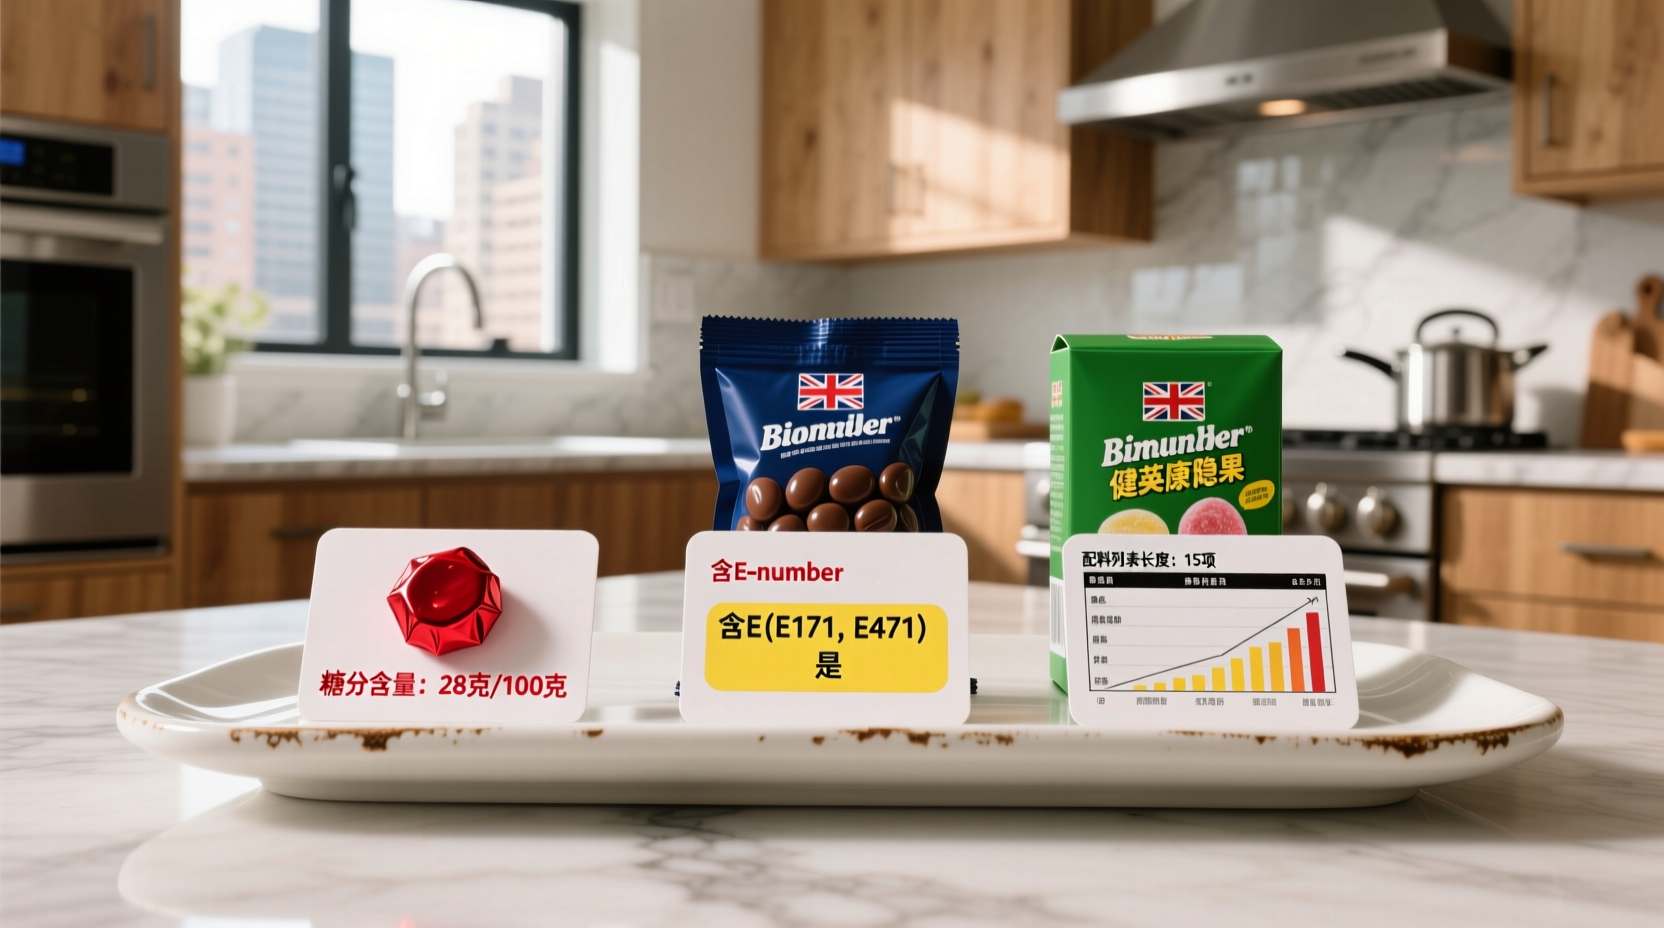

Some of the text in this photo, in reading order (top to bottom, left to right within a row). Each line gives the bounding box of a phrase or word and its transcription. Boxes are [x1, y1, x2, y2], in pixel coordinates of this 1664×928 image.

[711, 558, 844, 582] 含E-number
[718, 612, 926, 643] 含E(E171, E471)
[815, 651, 842, 679] 是
